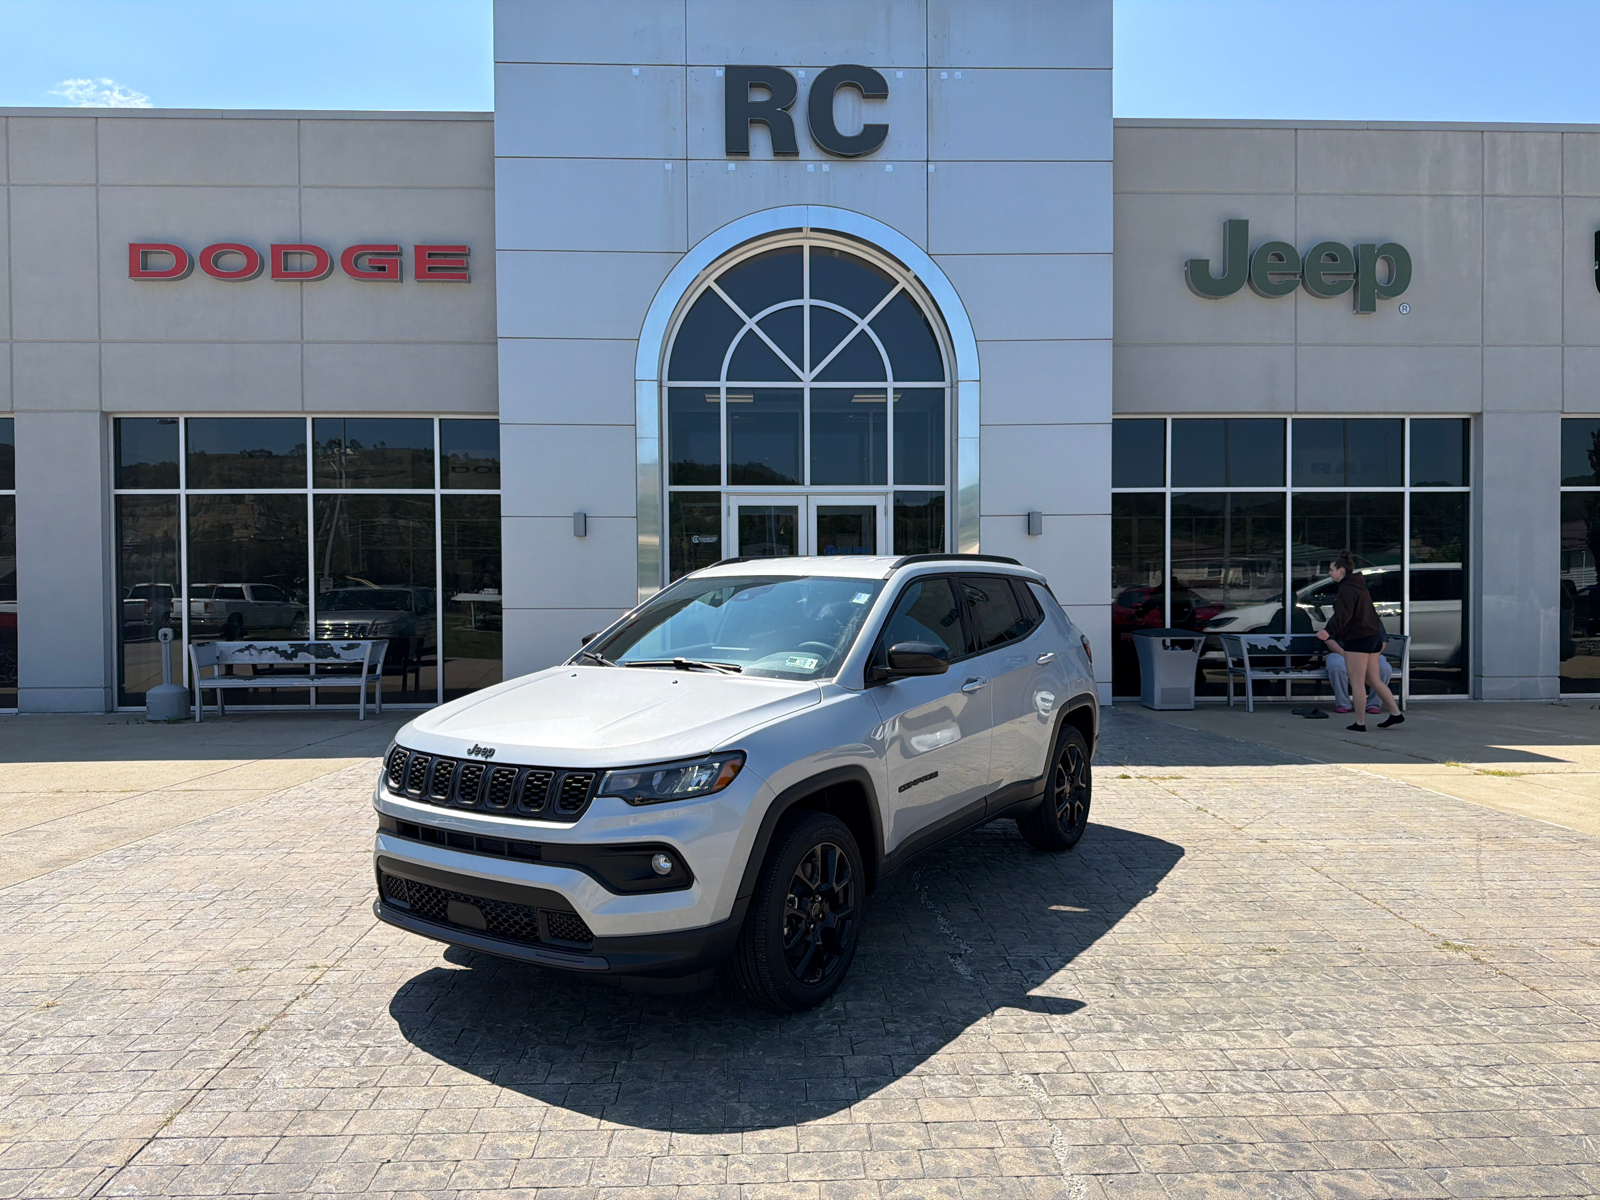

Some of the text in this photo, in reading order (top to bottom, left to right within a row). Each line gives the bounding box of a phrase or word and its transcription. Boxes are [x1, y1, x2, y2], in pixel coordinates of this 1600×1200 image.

[725, 64, 889, 159] RC
[128, 243, 471, 283] DODGE
[1184, 219, 1413, 315] Jeep
[467, 743, 496, 760] Jeep
